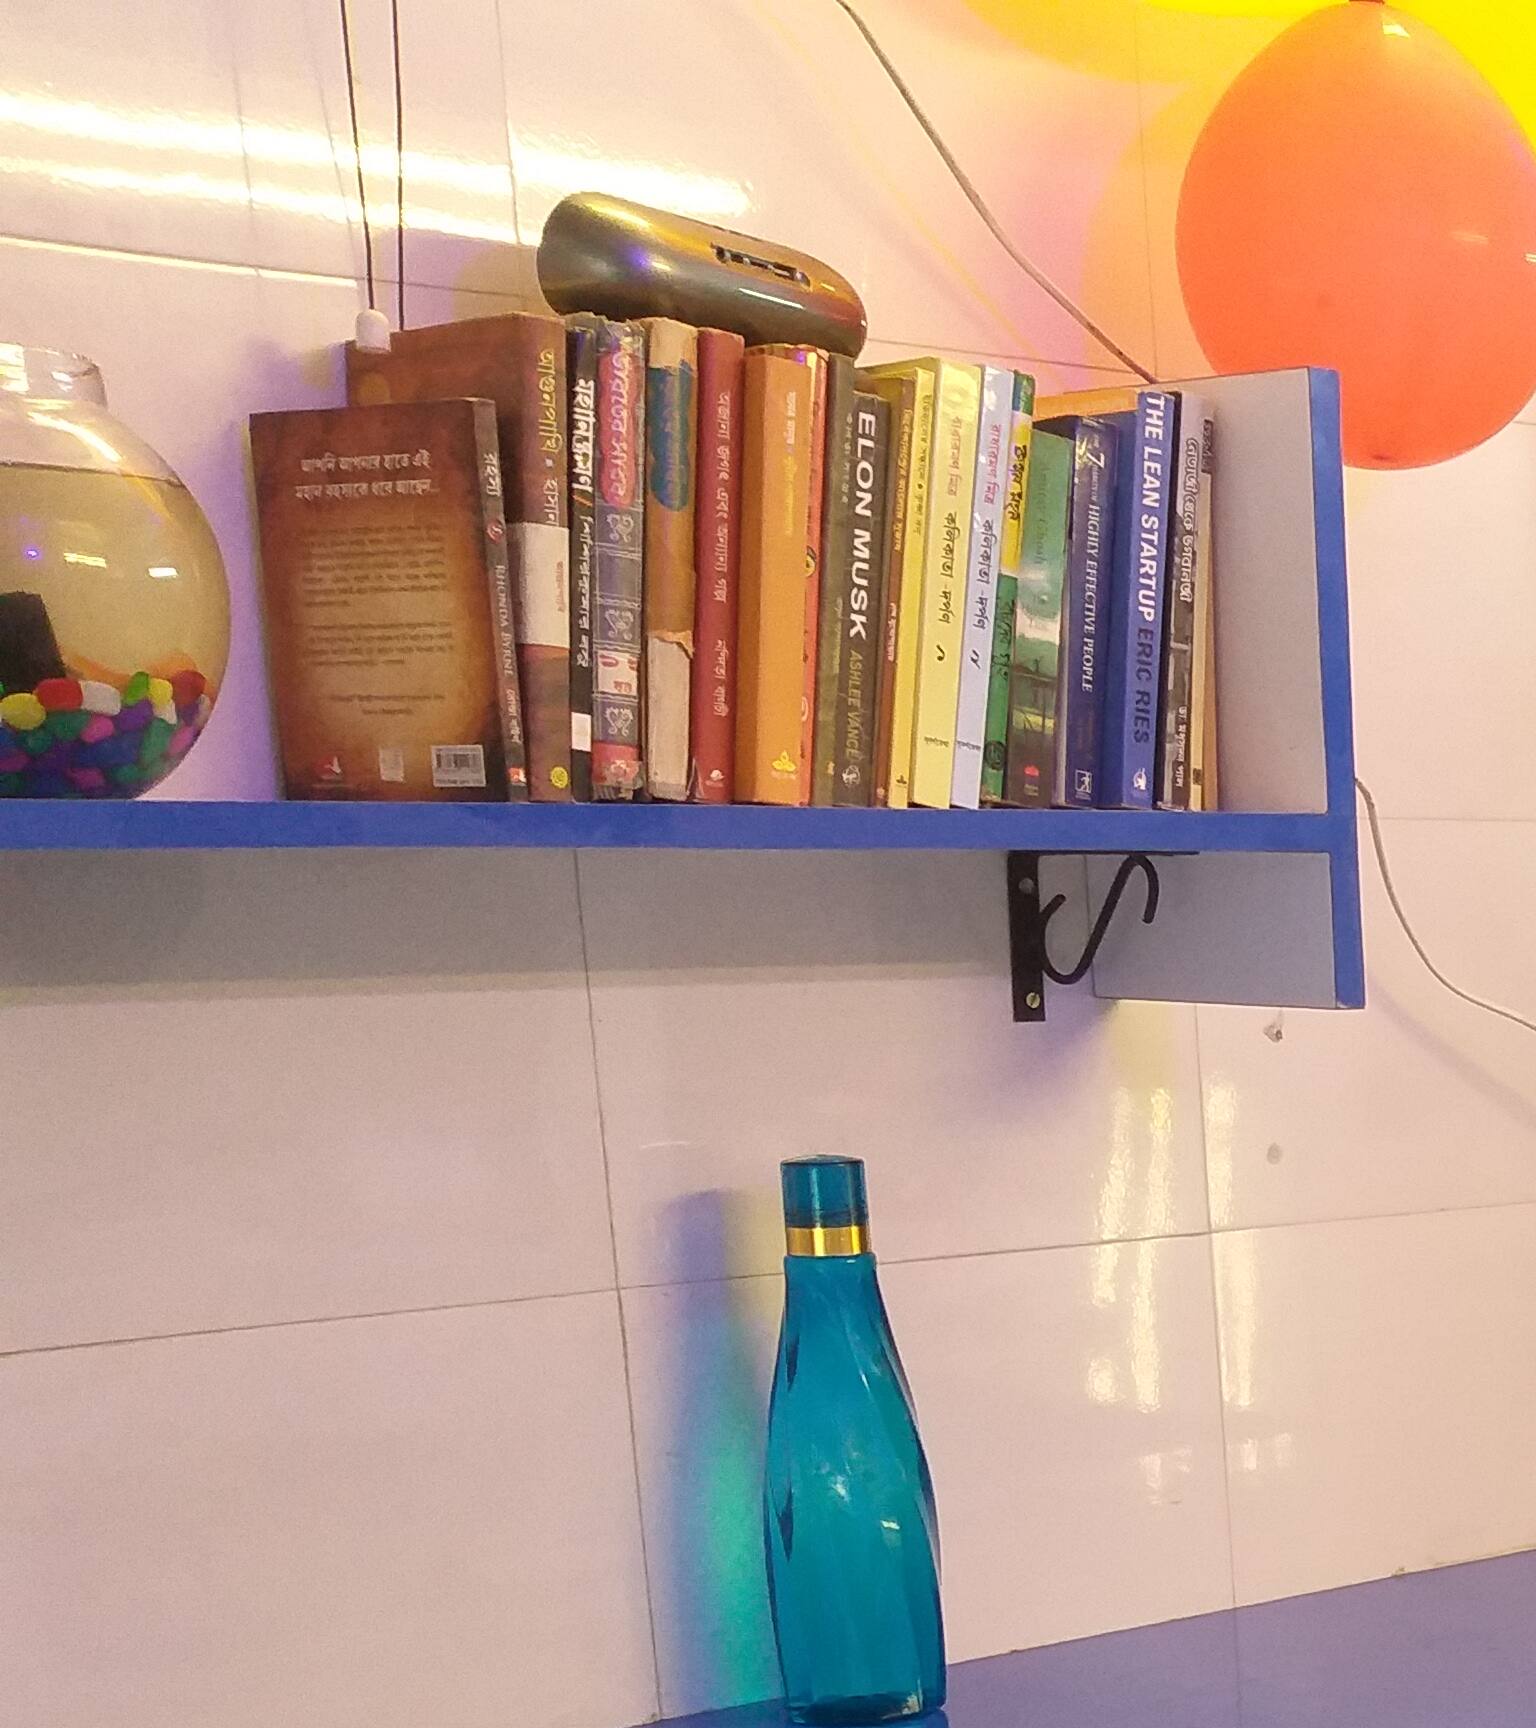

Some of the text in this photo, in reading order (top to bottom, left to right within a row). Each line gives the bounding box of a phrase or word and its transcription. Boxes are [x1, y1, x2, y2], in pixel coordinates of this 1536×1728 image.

[848, 411, 876, 641] ELON MUSK
[1087, 504, 1100, 559] HIGHLY
[1139, 395, 1164, 621] THE LEAN STARTUP
[1083, 559, 1098, 634] EFFECTIVE
[844, 649, 864, 761] ASHLEE VANCE
[1082, 638, 1094, 692] PEOPLE
[1134, 627, 1153, 743] ERIC RIES
